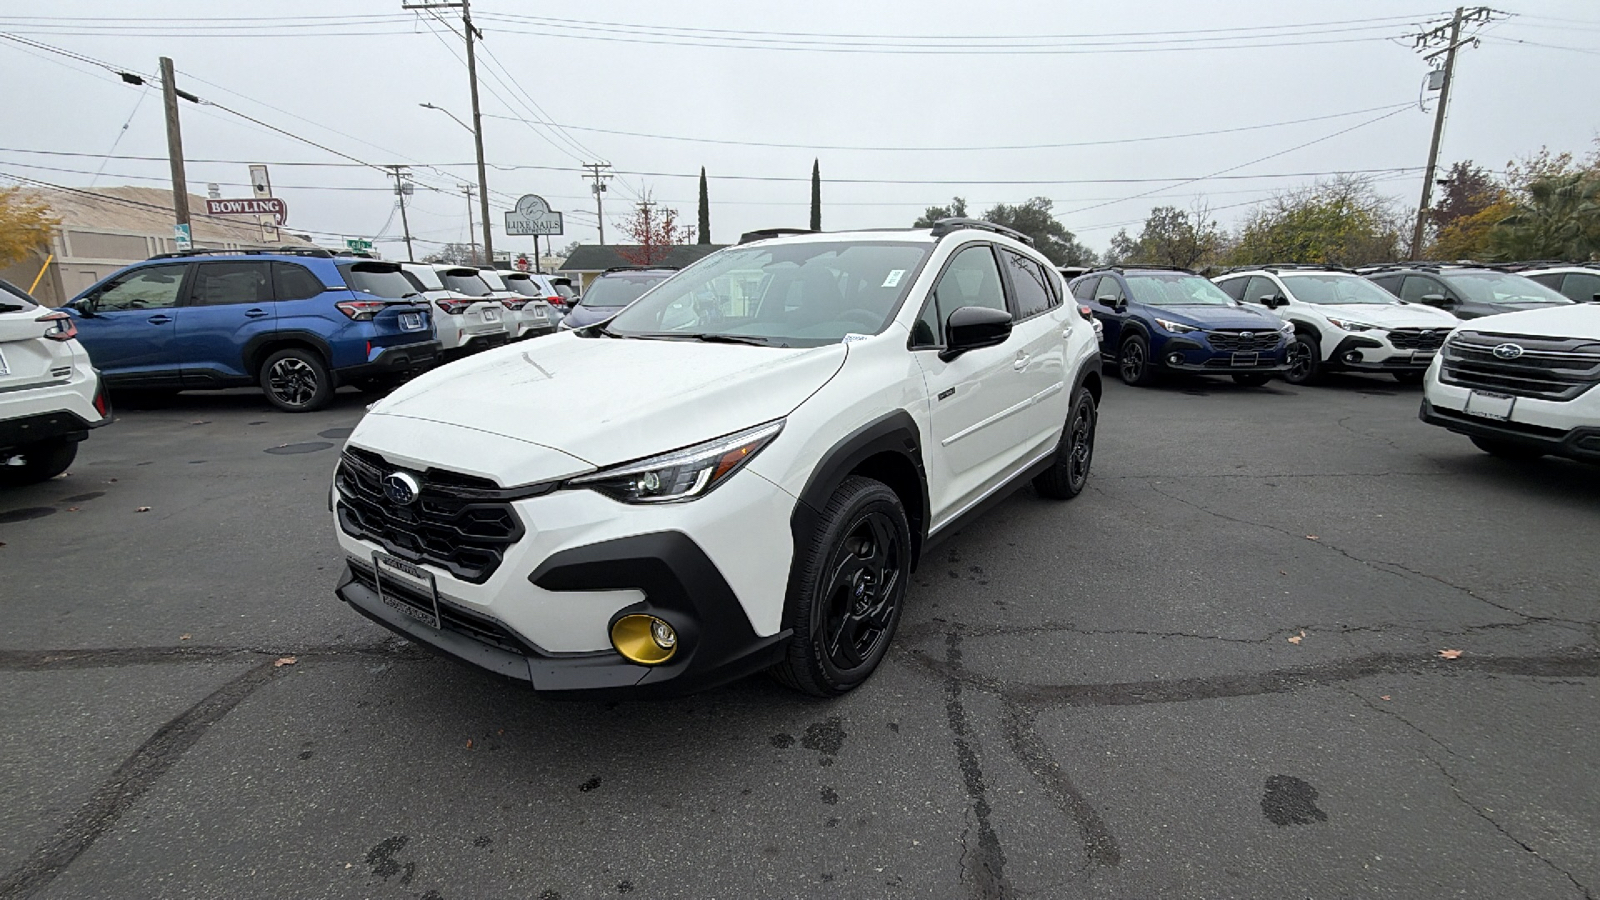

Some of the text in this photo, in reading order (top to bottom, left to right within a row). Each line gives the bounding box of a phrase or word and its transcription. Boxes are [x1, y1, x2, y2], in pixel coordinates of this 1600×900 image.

[210, 201, 280, 213] BOWLING
[507, 220, 560, 229] LUXE NAILS
